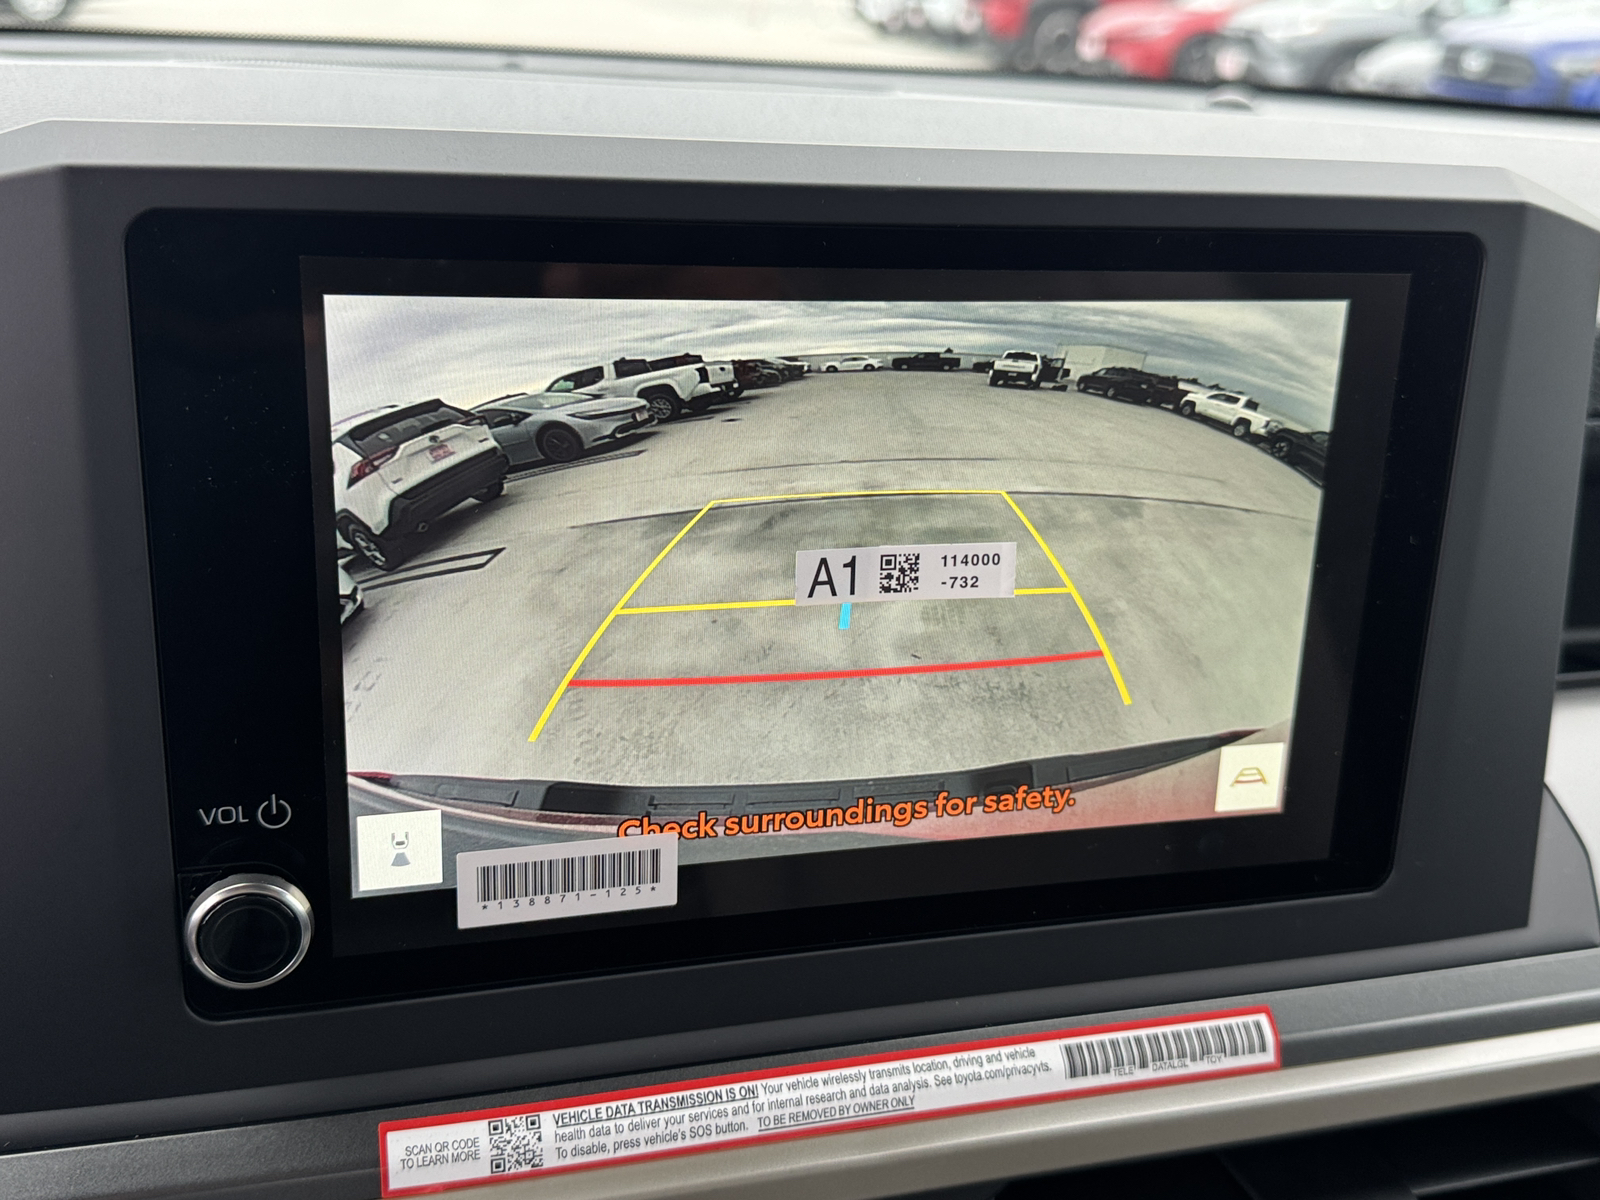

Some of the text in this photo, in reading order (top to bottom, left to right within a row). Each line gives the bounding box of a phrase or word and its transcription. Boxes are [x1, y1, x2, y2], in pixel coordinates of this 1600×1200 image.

[941, 553, 1001, 567] 114000
[807, 555, 857, 598] A1
[941, 576, 979, 588] -732
[199, 805, 249, 825] VOL
[724, 798, 928, 837] surroundings
[935, 791, 977, 817] for
[983, 785, 1076, 814] safety.
[1112, 1066, 1134, 1077] TELE
[553, 1046, 1036, 1127] VEHICLE DATA TRANSMISSION IS ON! Your vehicle wirelessly transmits location, driving and vehicle
[554, 1124, 586, 1143] health
[589, 1122, 611, 1138] data
[614, 1122, 625, 1134] to
[628, 1116, 661, 1132] deliver
[663, 1112, 686, 1129] your
[688, 1107, 729, 1123] services
[732, 1101, 750, 1116] and
[752, 1100, 765, 1113] for
[767, 1093, 803, 1110] internal
[805, 1087, 847, 1104] research
[849, 1085, 867, 1099] and
[869, 1081, 890, 1096] data
[892, 1076, 932, 1093] analysis.
[933, 1074, 952, 1087] See
[555, 1095, 915, 1160] To disable, press vehicle's SOS button. TO BE REMOVED BY OWNER ONLY
[404, 1137, 480, 1158] SCAN QR CODE
[400, 1149, 481, 1170] TO LEARN MORE
